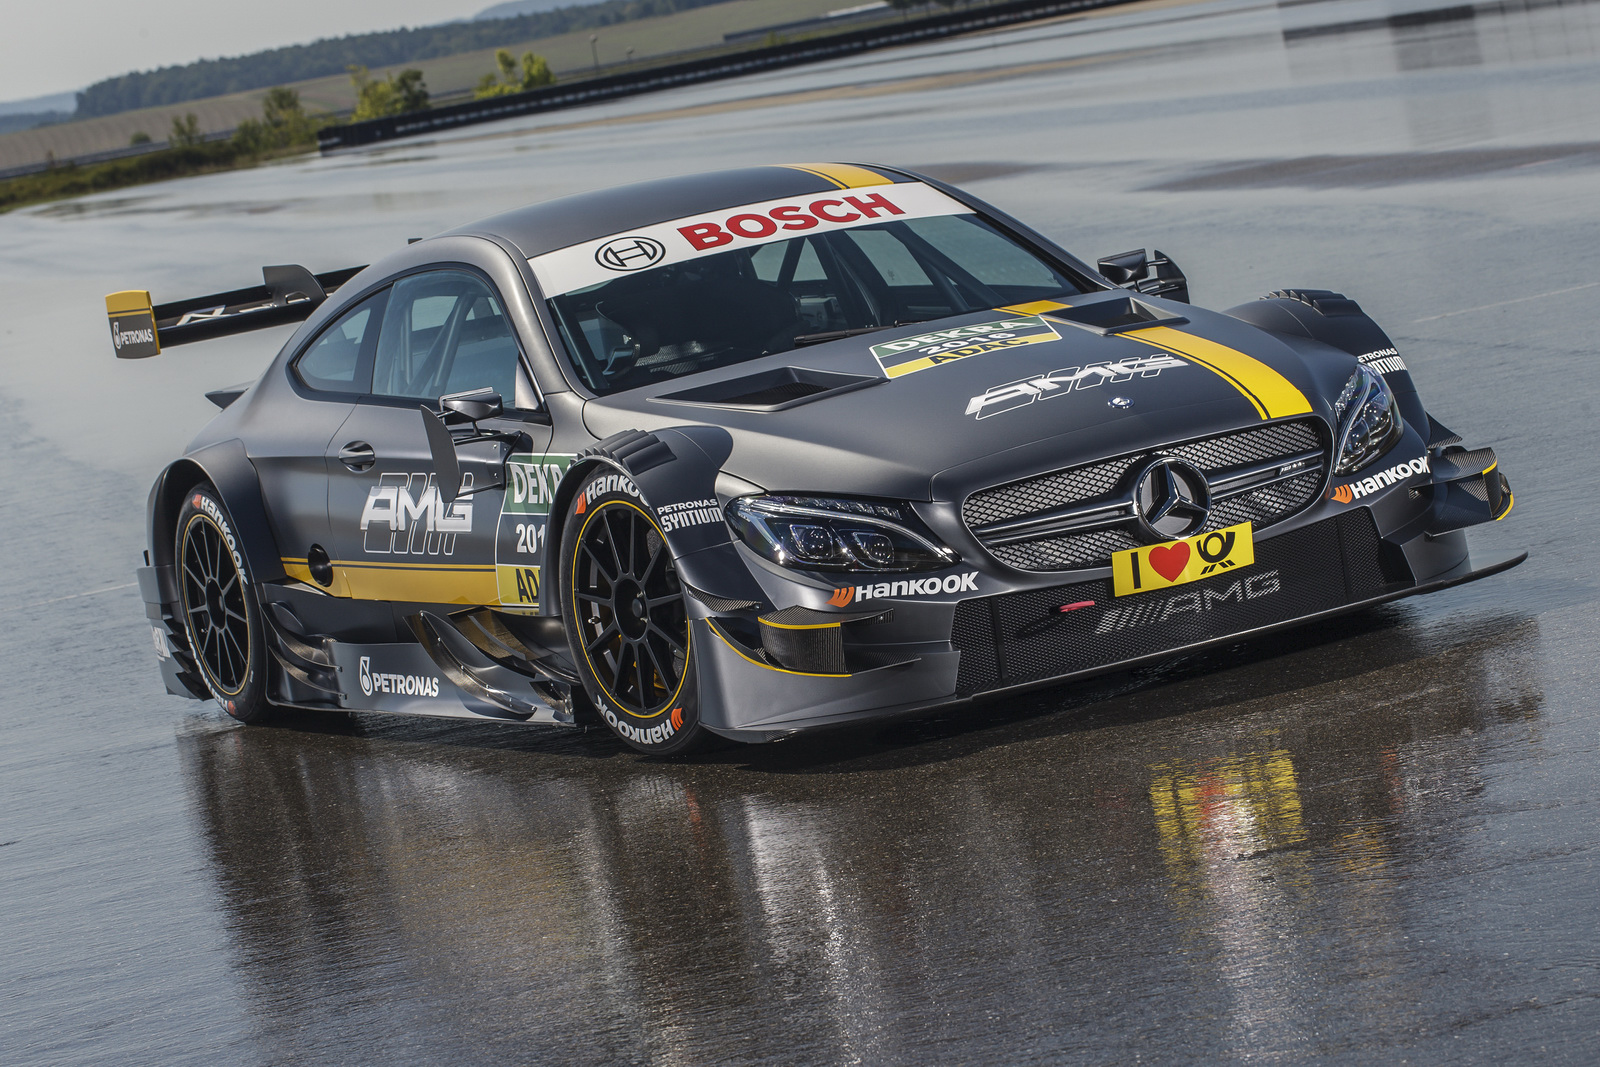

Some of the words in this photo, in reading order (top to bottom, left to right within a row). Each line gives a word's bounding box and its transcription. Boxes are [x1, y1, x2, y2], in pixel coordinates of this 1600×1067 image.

[676, 193, 906, 251] BOSCH
[120, 328, 154, 346] PETRONAS
[881, 321, 1039, 351] DEKRA
[918, 332, 1016, 355] 2016
[928, 339, 1030, 365] ADAC
[1357, 347, 1398, 363] ETRONAS
[509, 463, 572, 504] DEKR
[360, 484, 474, 534] AMG
[656, 499, 718, 516] PETRONAS
[660, 507, 725, 533] SYNTIUM
[515, 523, 546, 554] 201
[515, 568, 541, 603] AD
[372, 672, 439, 698] PETRONAS
